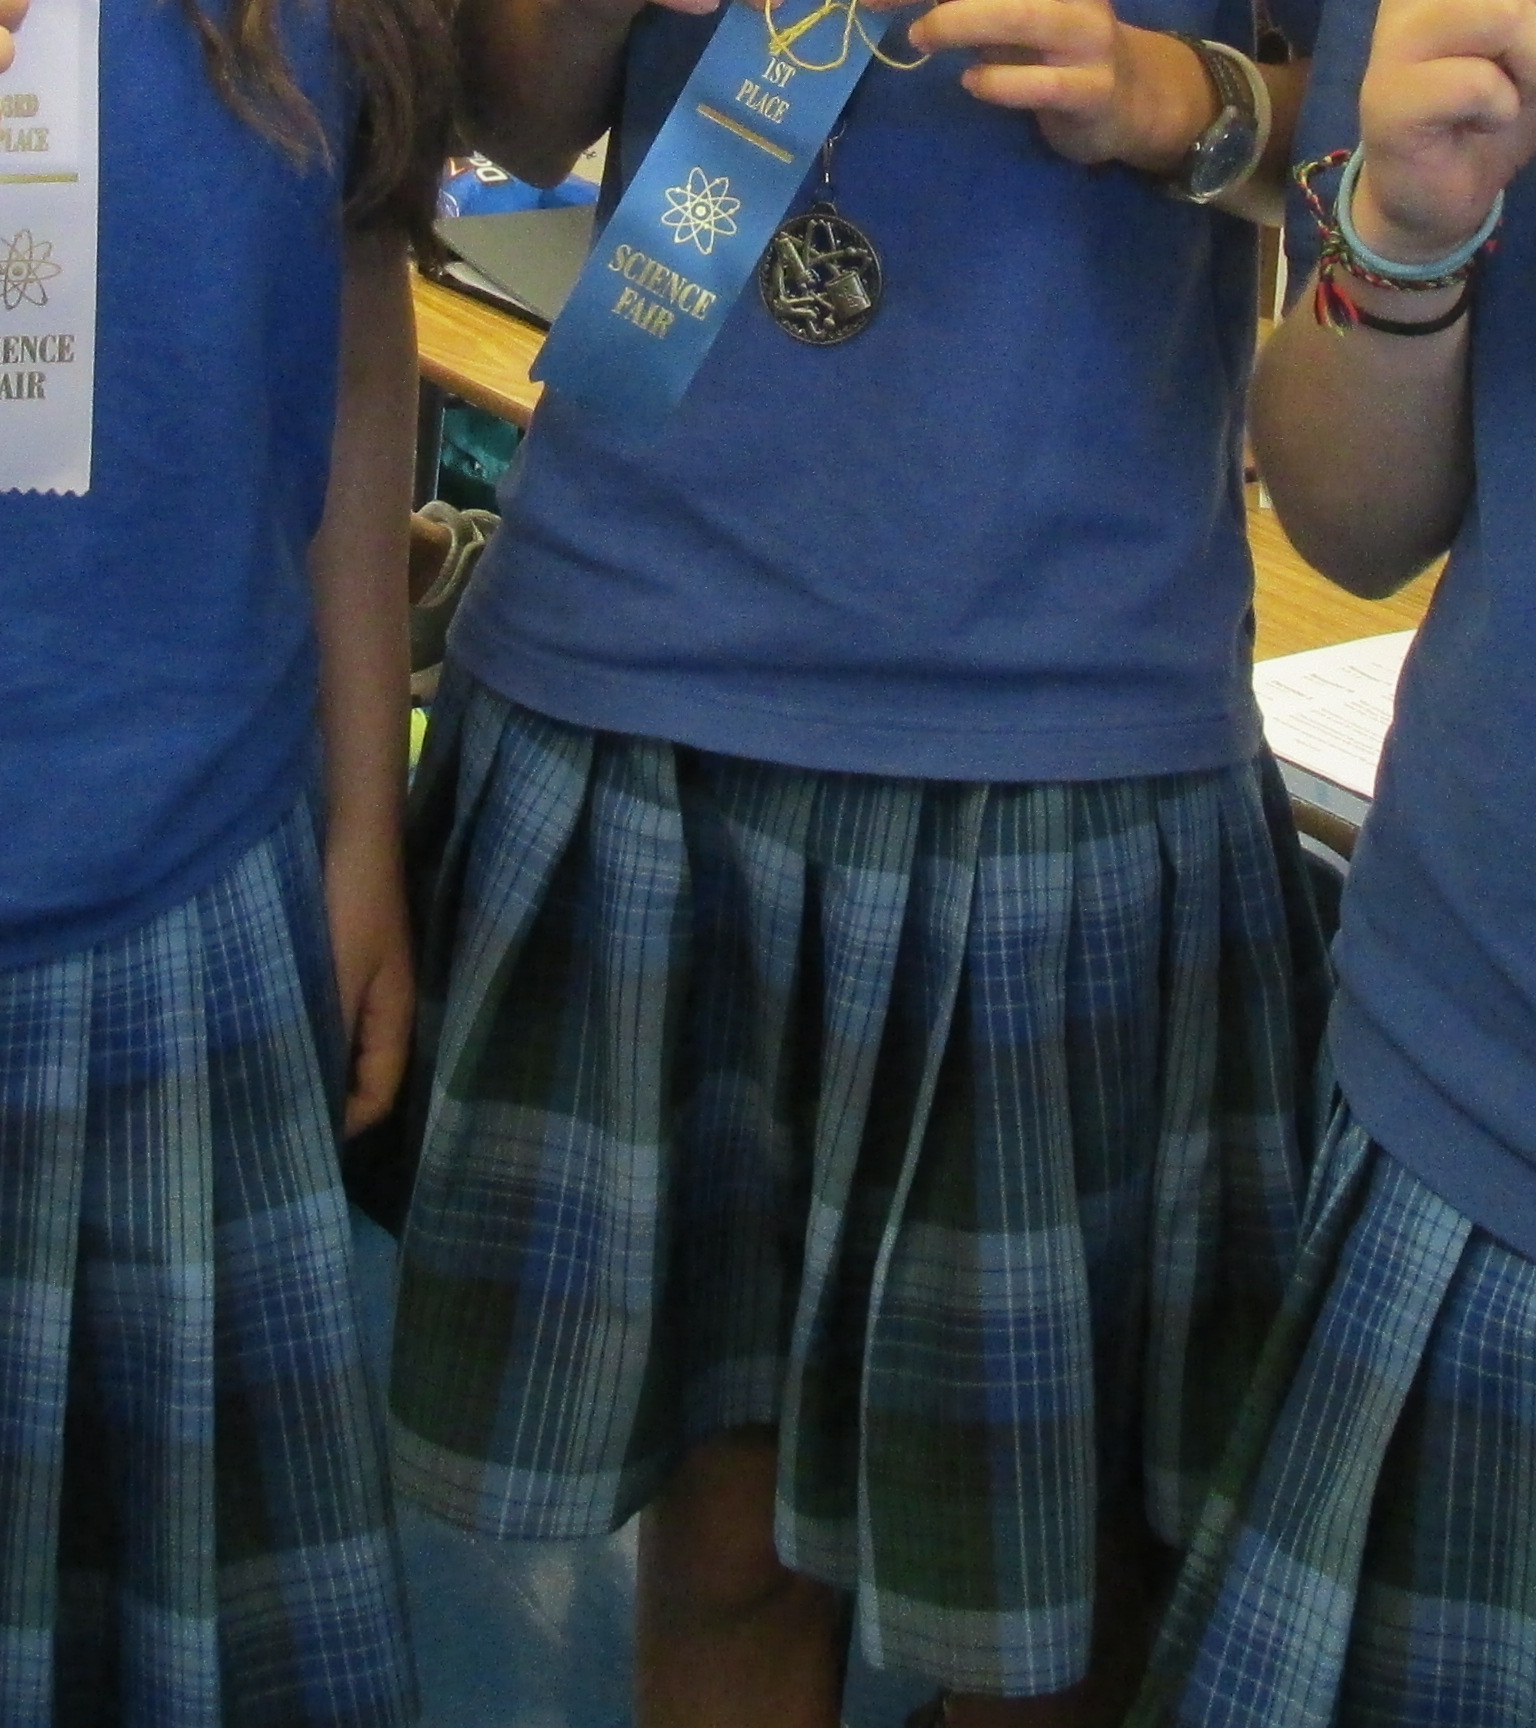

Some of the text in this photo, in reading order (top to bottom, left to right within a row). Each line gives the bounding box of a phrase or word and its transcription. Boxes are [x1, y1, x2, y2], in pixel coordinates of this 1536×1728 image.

[761, 56, 797, 88] 1ST
[735, 79, 791, 124] PLACE
[608, 244, 718, 321] SCIENCE
[612, 287, 677, 339] FAIR
